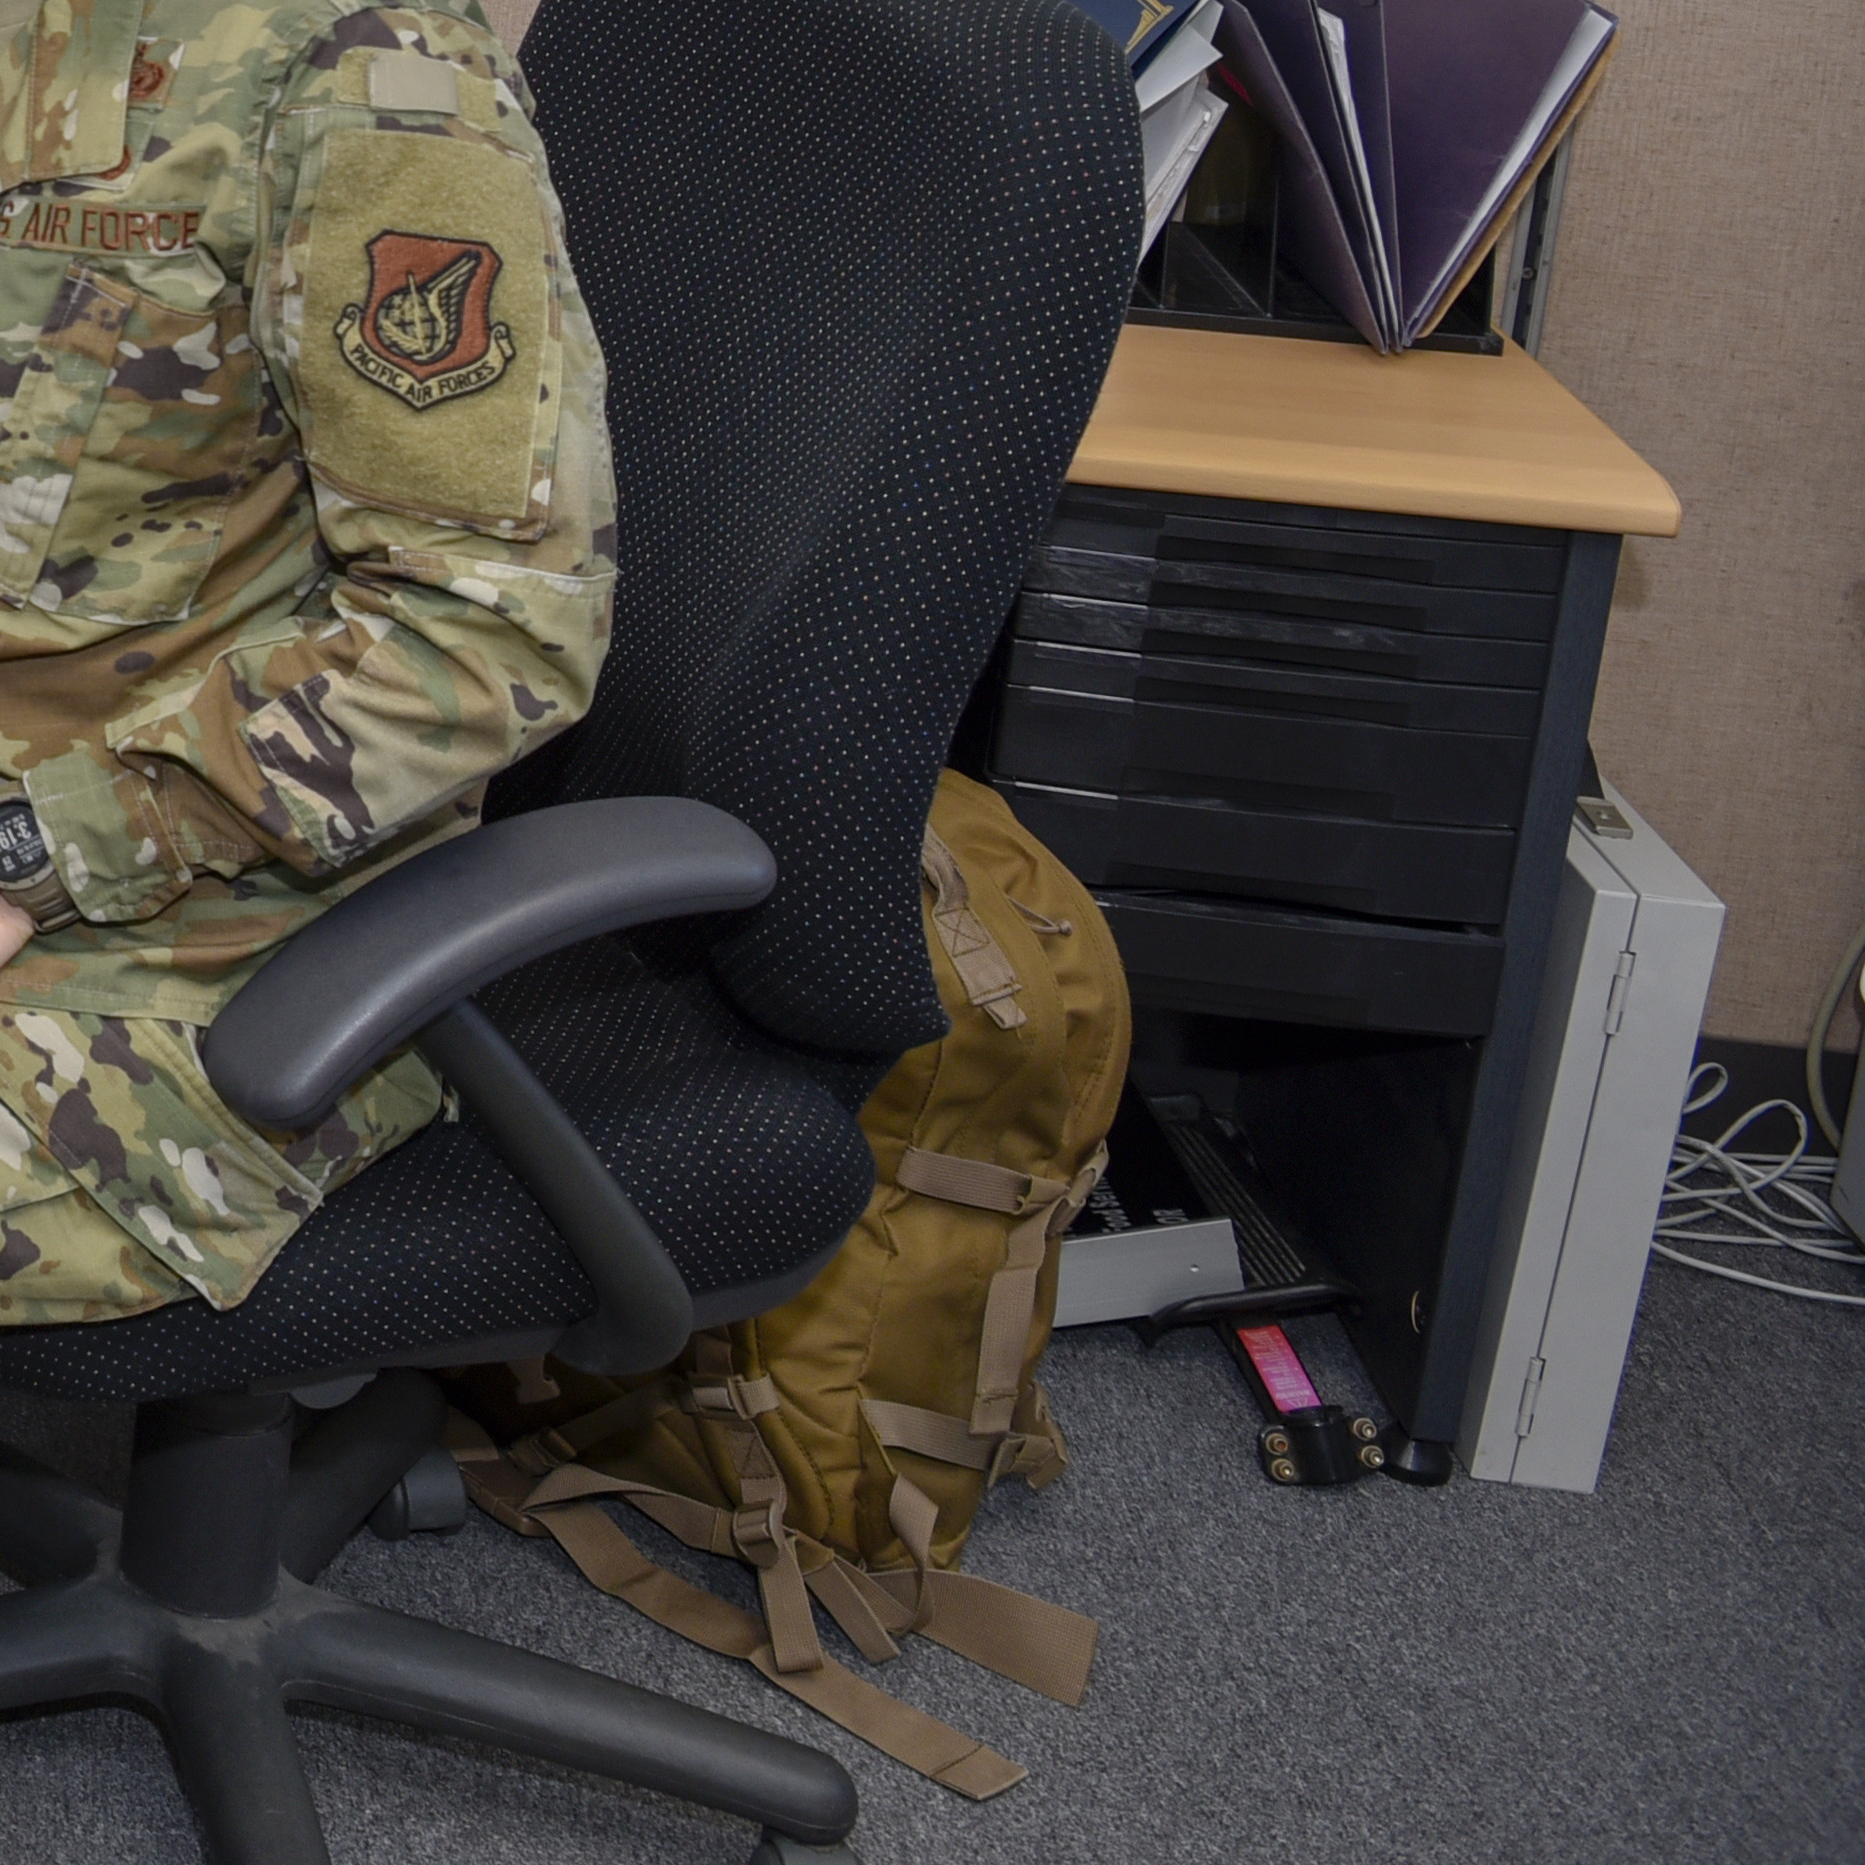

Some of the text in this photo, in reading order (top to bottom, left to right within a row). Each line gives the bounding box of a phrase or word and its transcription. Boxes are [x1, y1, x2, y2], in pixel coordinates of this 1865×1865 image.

[22, 201, 70, 240] AIR
[79, 208, 199, 253] FORCE
[350, 343, 496, 403] PACIFIC AIR FORCES
